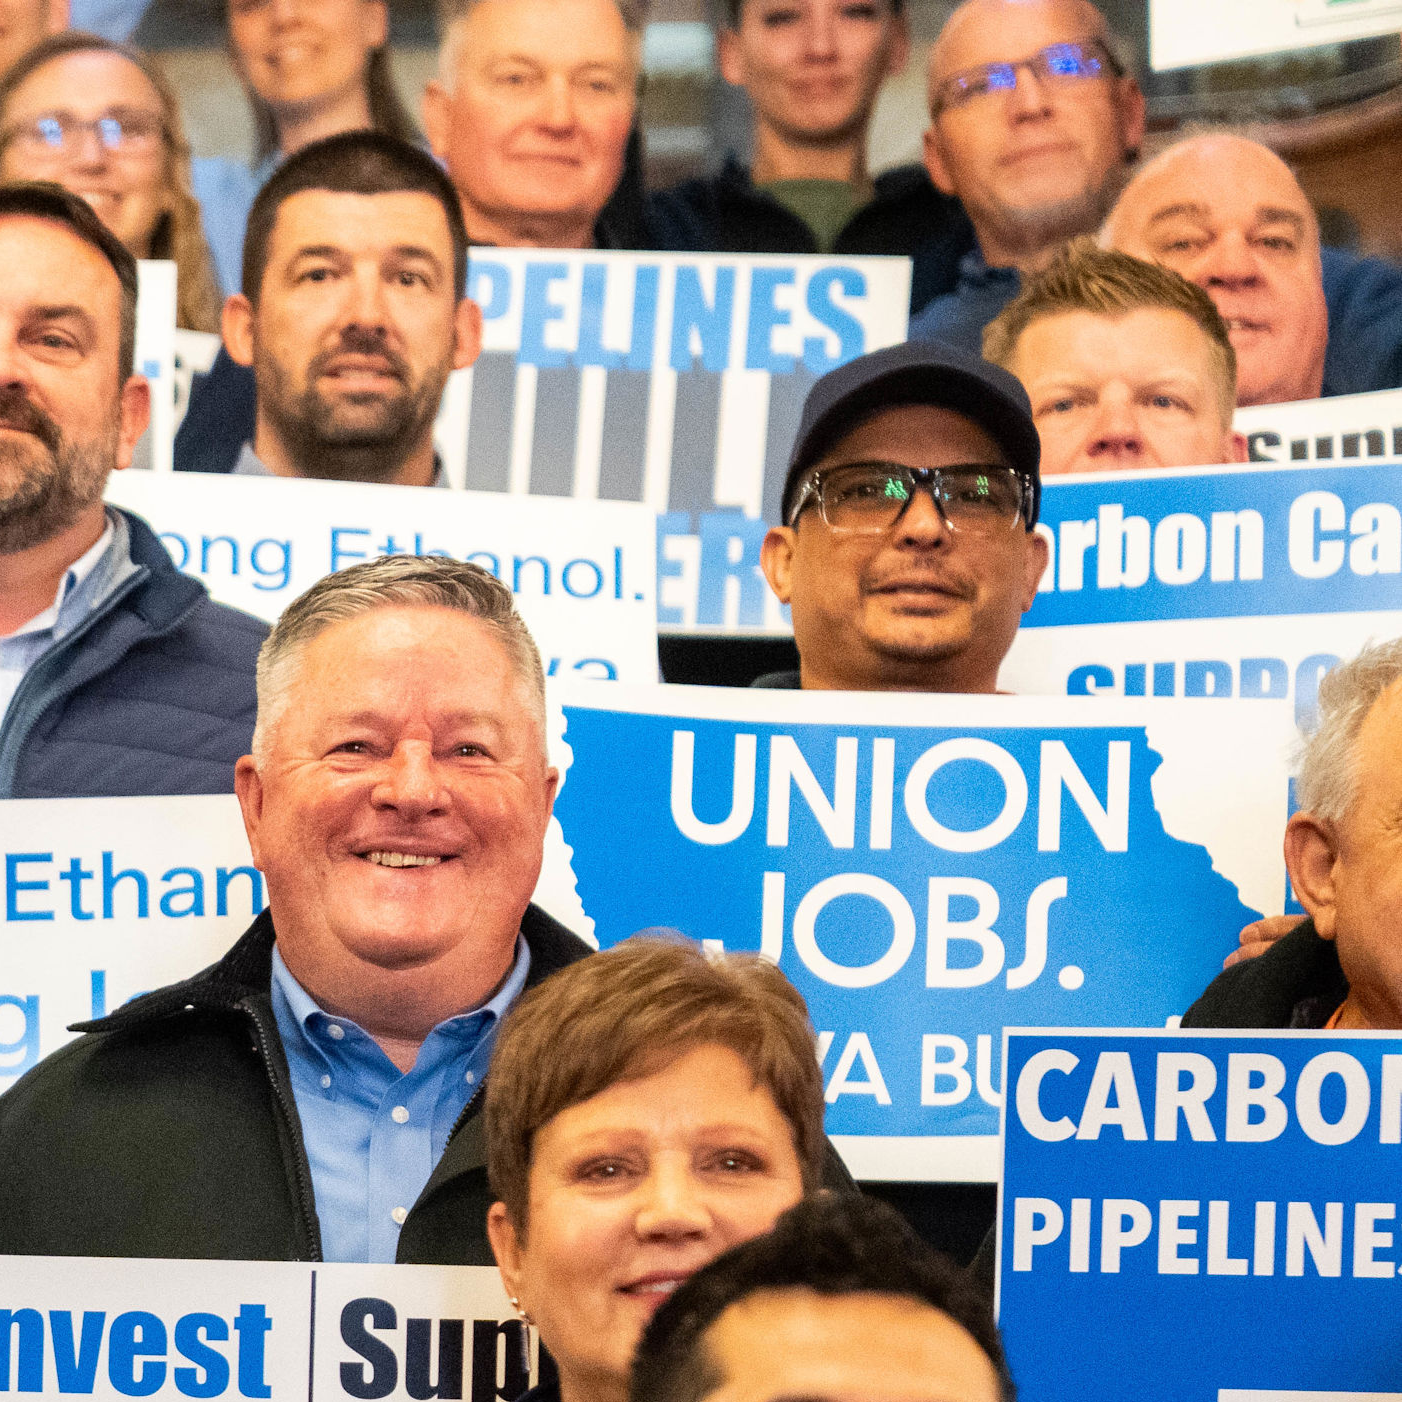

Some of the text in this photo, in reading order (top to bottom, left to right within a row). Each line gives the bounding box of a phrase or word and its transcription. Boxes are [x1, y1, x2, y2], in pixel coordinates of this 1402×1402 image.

[670, 729, 1133, 853] UNION
[702, 870, 1085, 991] JOBS.
[1012, 1197, 1402, 1279] PIPELINE
